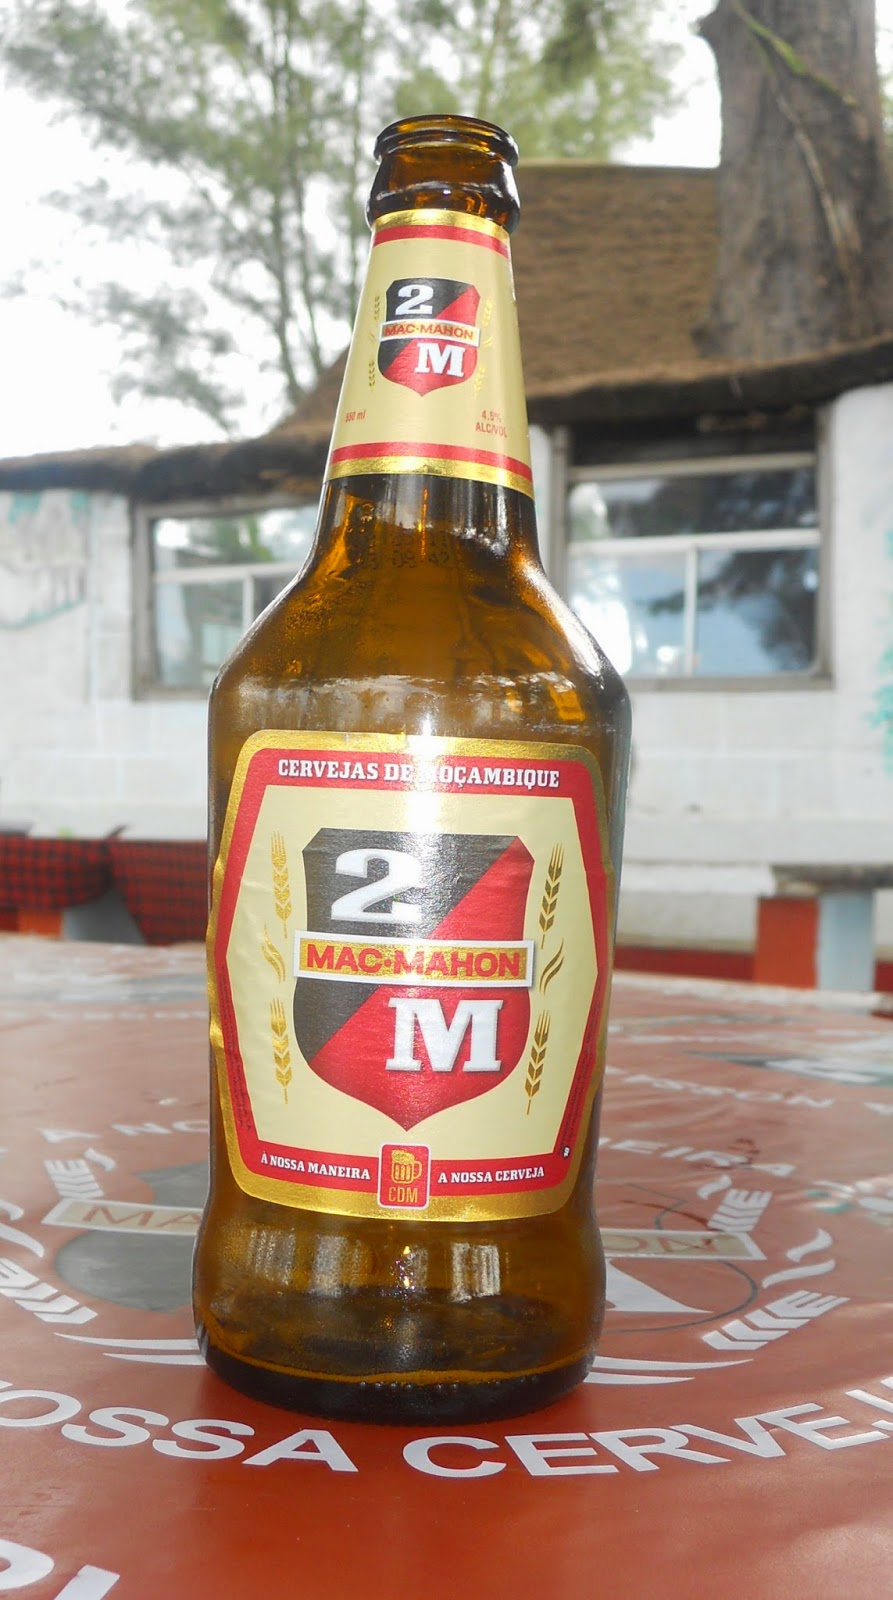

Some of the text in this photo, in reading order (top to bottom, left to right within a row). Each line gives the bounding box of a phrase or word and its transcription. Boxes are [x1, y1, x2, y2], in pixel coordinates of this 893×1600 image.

[395, 284, 434, 316] 2
[414, 342, 466, 377] M
[277, 758, 379, 781] CERVEJAS
[384, 762, 412, 783] DE
[330, 847, 423, 924] 2
[385, 996, 504, 1073] M
[269, 1154, 306, 1173] NOSSA
[307, 1162, 371, 1181] MANEIRA
[437, 1165, 545, 1184] A NOSSA CERVEJA
[387, 1186, 419, 1204] CDM
[0, 1376, 893, 1478] OSSA CERVEJ
